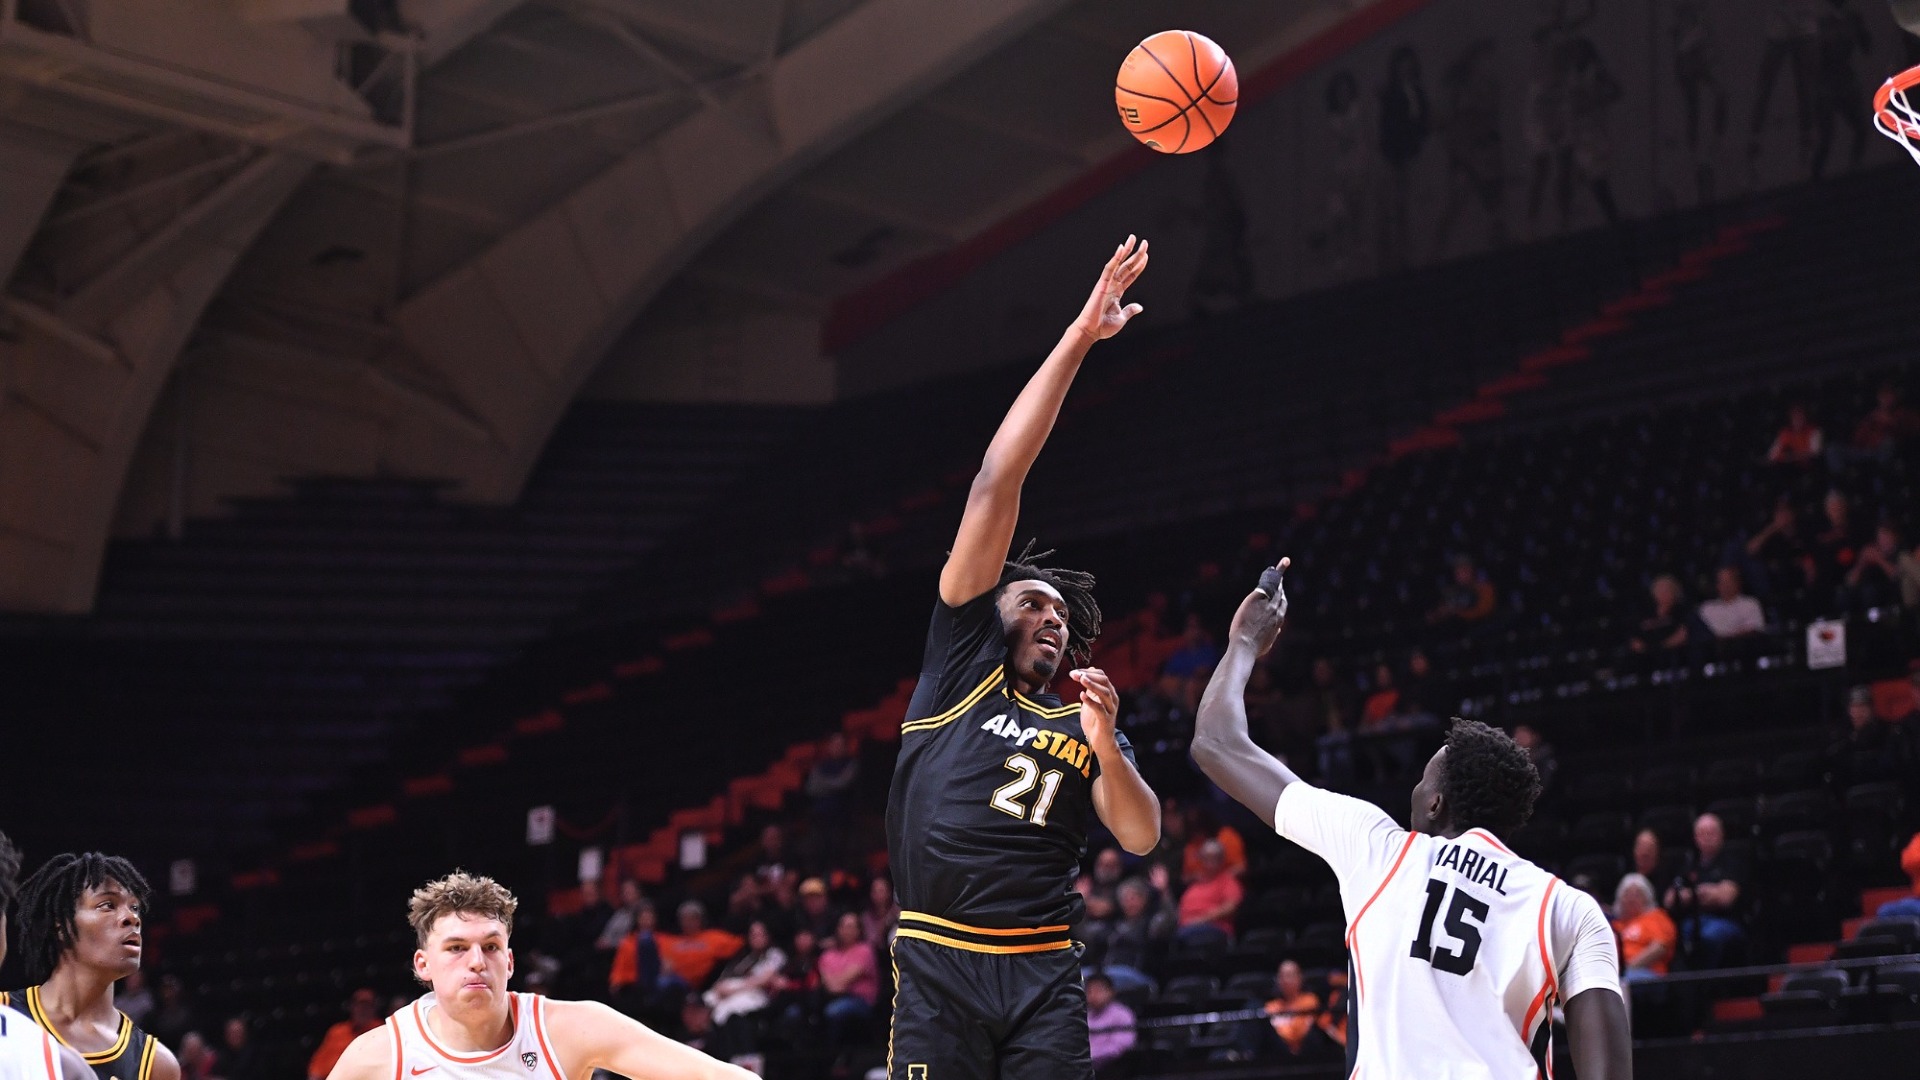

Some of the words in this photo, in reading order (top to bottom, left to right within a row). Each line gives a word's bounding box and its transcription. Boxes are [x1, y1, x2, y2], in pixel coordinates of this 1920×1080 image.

[980, 714, 1090, 778] APPSTAT
[990, 752, 1064, 827] 21
[1410, 878, 1490, 976] 15
